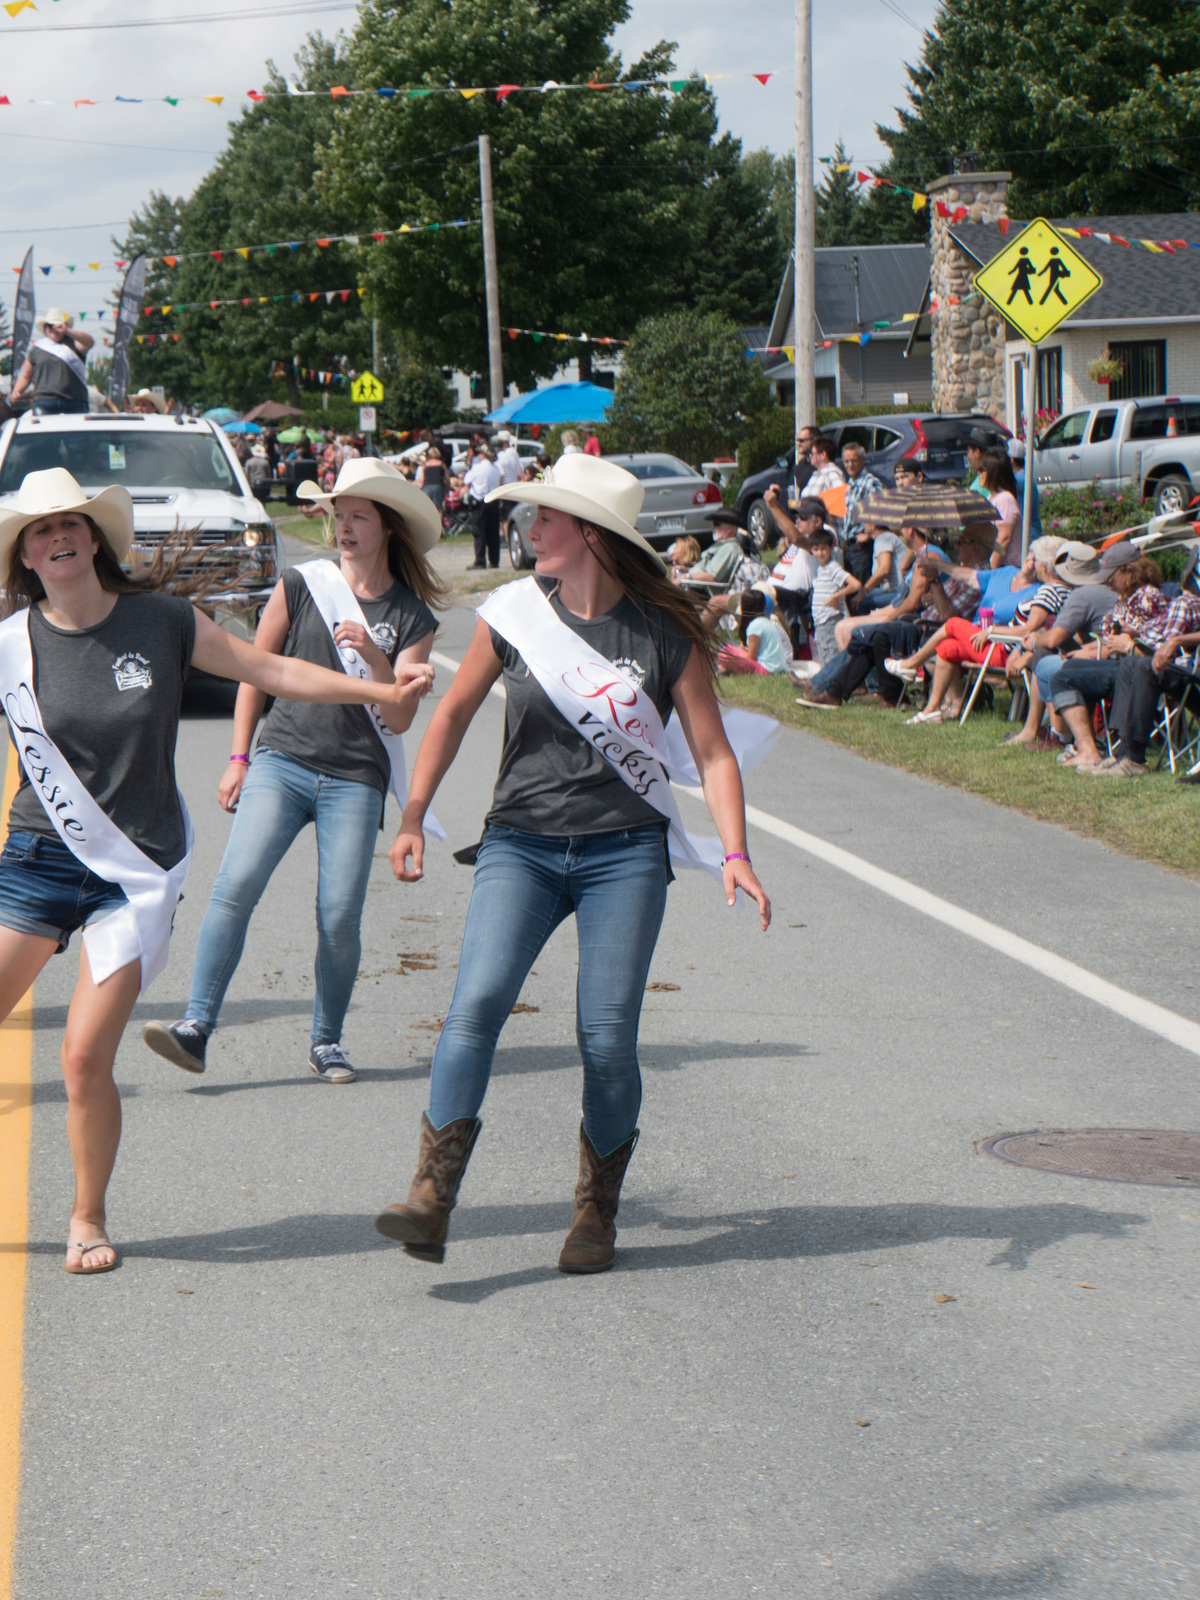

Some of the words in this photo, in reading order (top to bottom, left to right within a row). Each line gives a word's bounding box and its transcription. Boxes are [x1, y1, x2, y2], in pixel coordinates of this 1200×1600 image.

[562, 662, 654, 748] Rei
[6, 682, 86, 841] Jessie
[578, 711, 658, 796] Vicky
